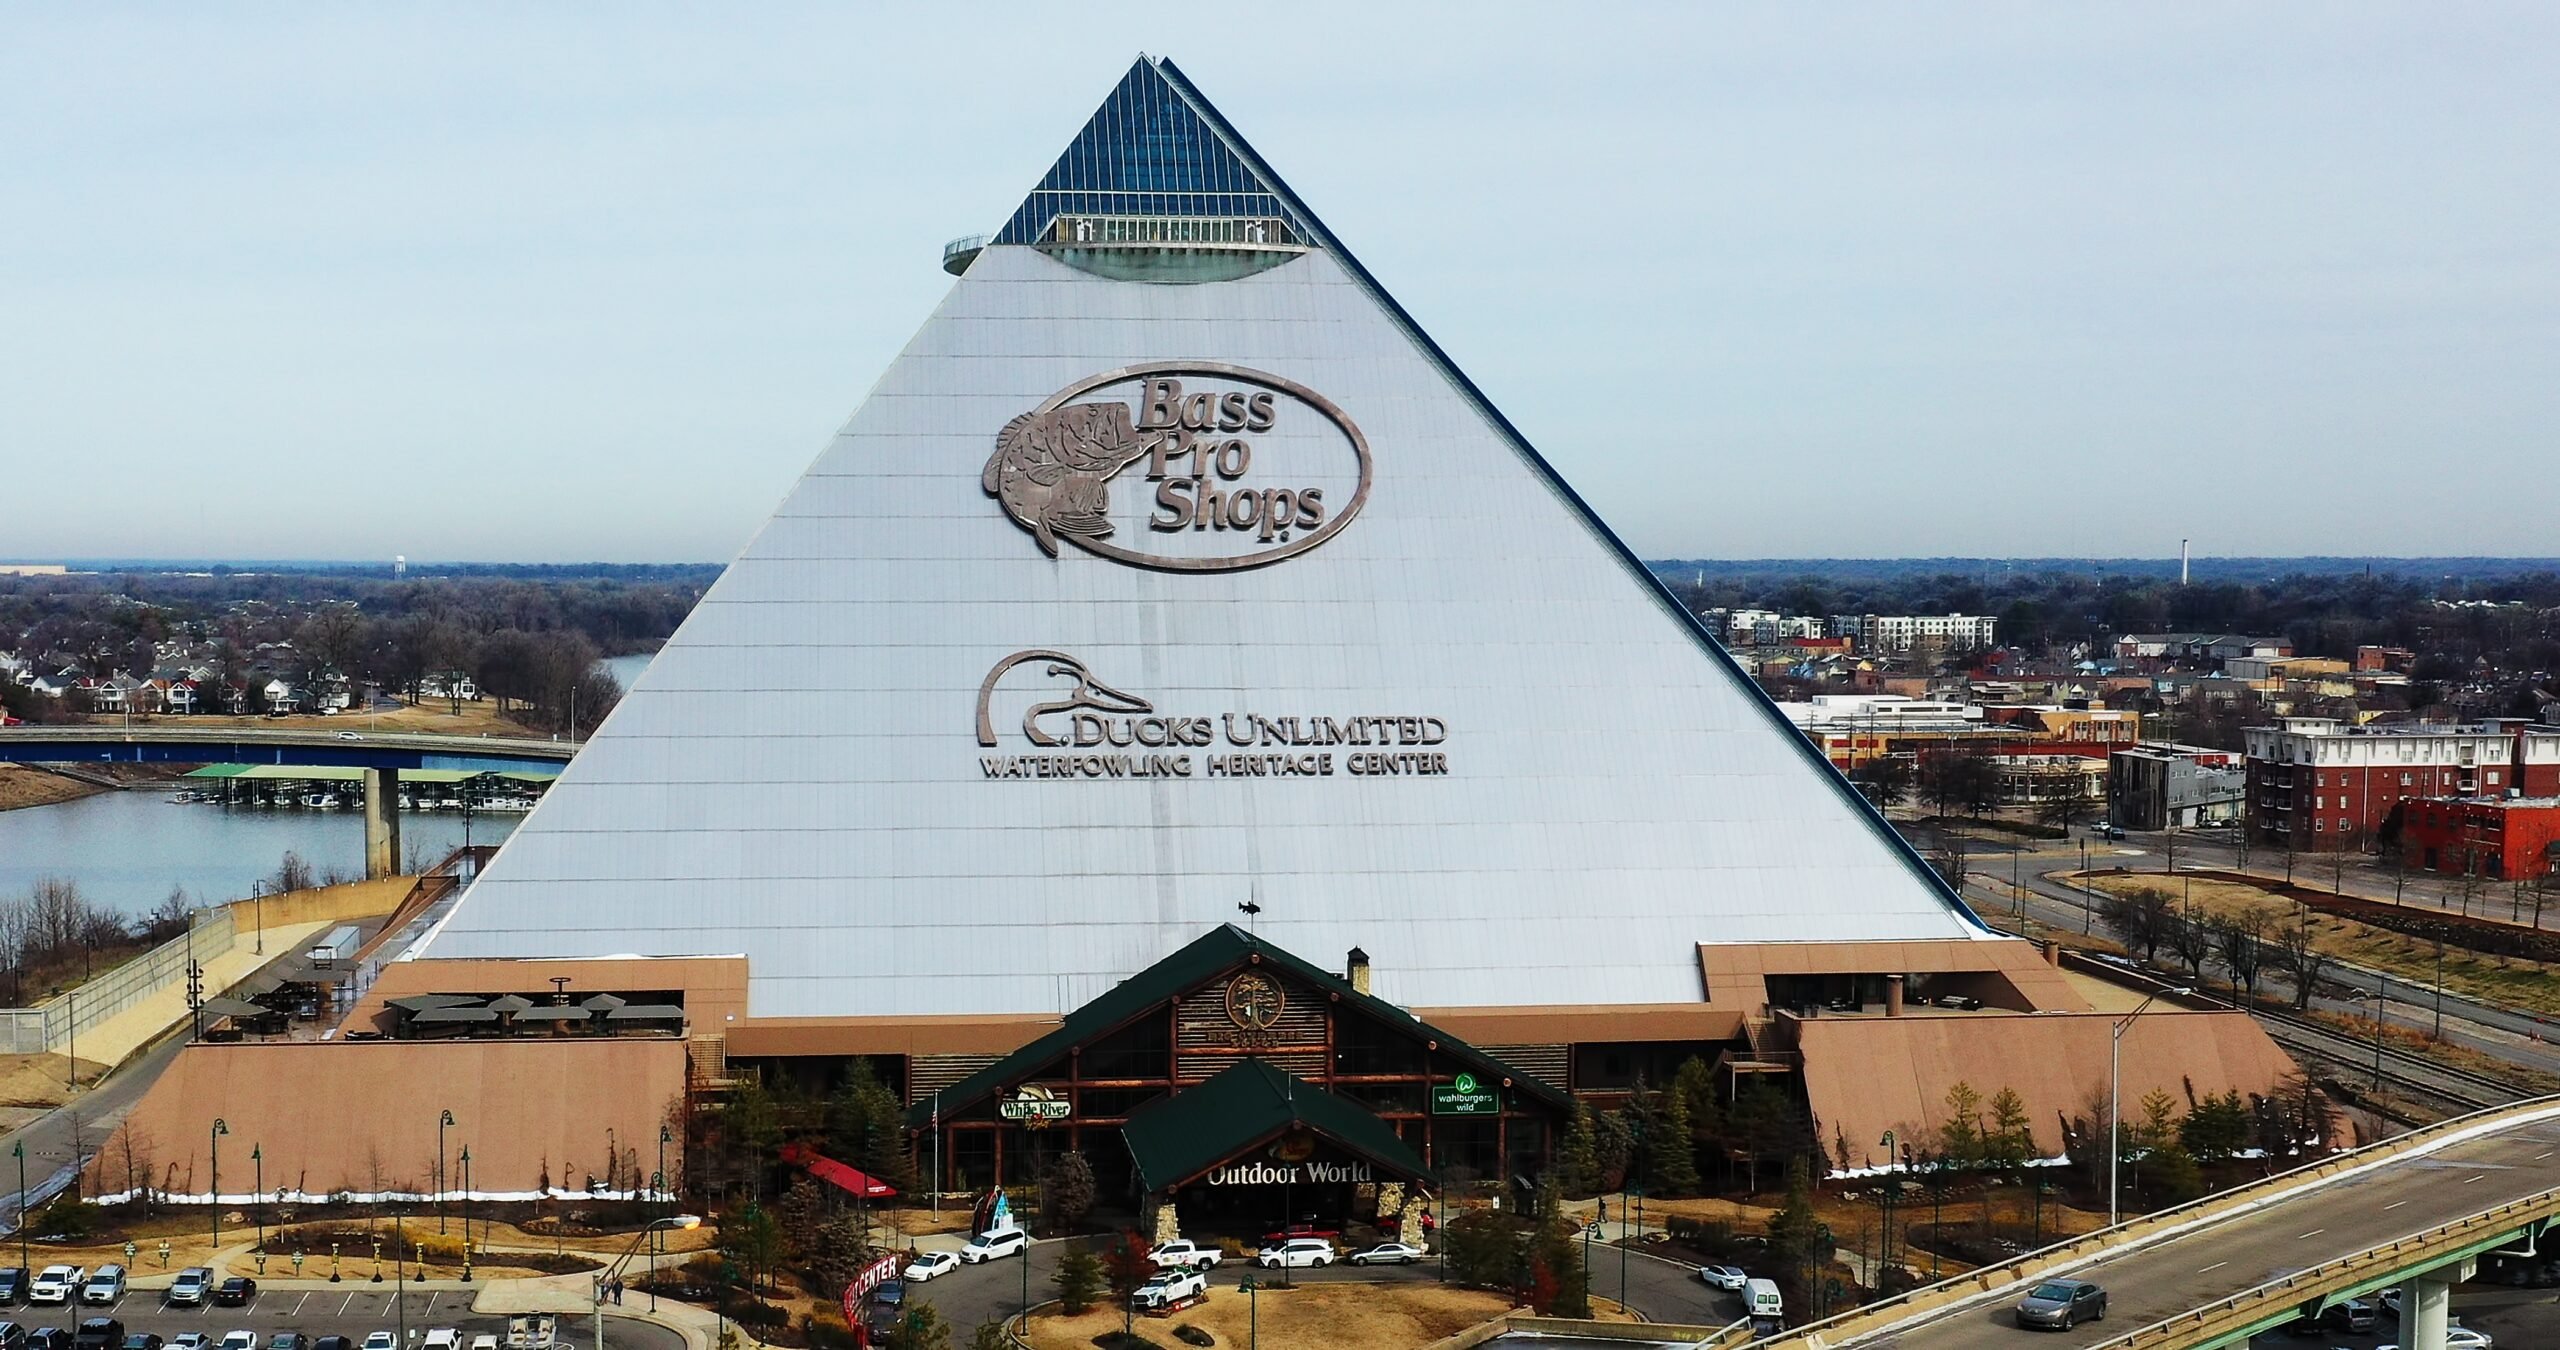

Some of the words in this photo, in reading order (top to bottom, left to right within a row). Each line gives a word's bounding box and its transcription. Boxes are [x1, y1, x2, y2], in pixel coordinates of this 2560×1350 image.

[1136, 378, 1275, 430] Bass
[1148, 428, 1250, 479] Pro
[1151, 477, 1325, 540] Shops
[1073, 714, 1213, 746] DUCKS
[1222, 713, 1448, 746] UNLIMITED
[980, 755, 1191, 778] WATERFOWLING
[1208, 753, 1334, 776] HERITAGE
[1347, 753, 1448, 775] CENTER
[1040, 1102, 1069, 1116] River
[1438, 1093, 1493, 1104] wahlburgers
[1456, 1103, 1474, 1112] wild
[1208, 1161, 1300, 1186] Outdoor
[1306, 1160, 1372, 1183] World
[859, 1256, 897, 1297] CENTER
